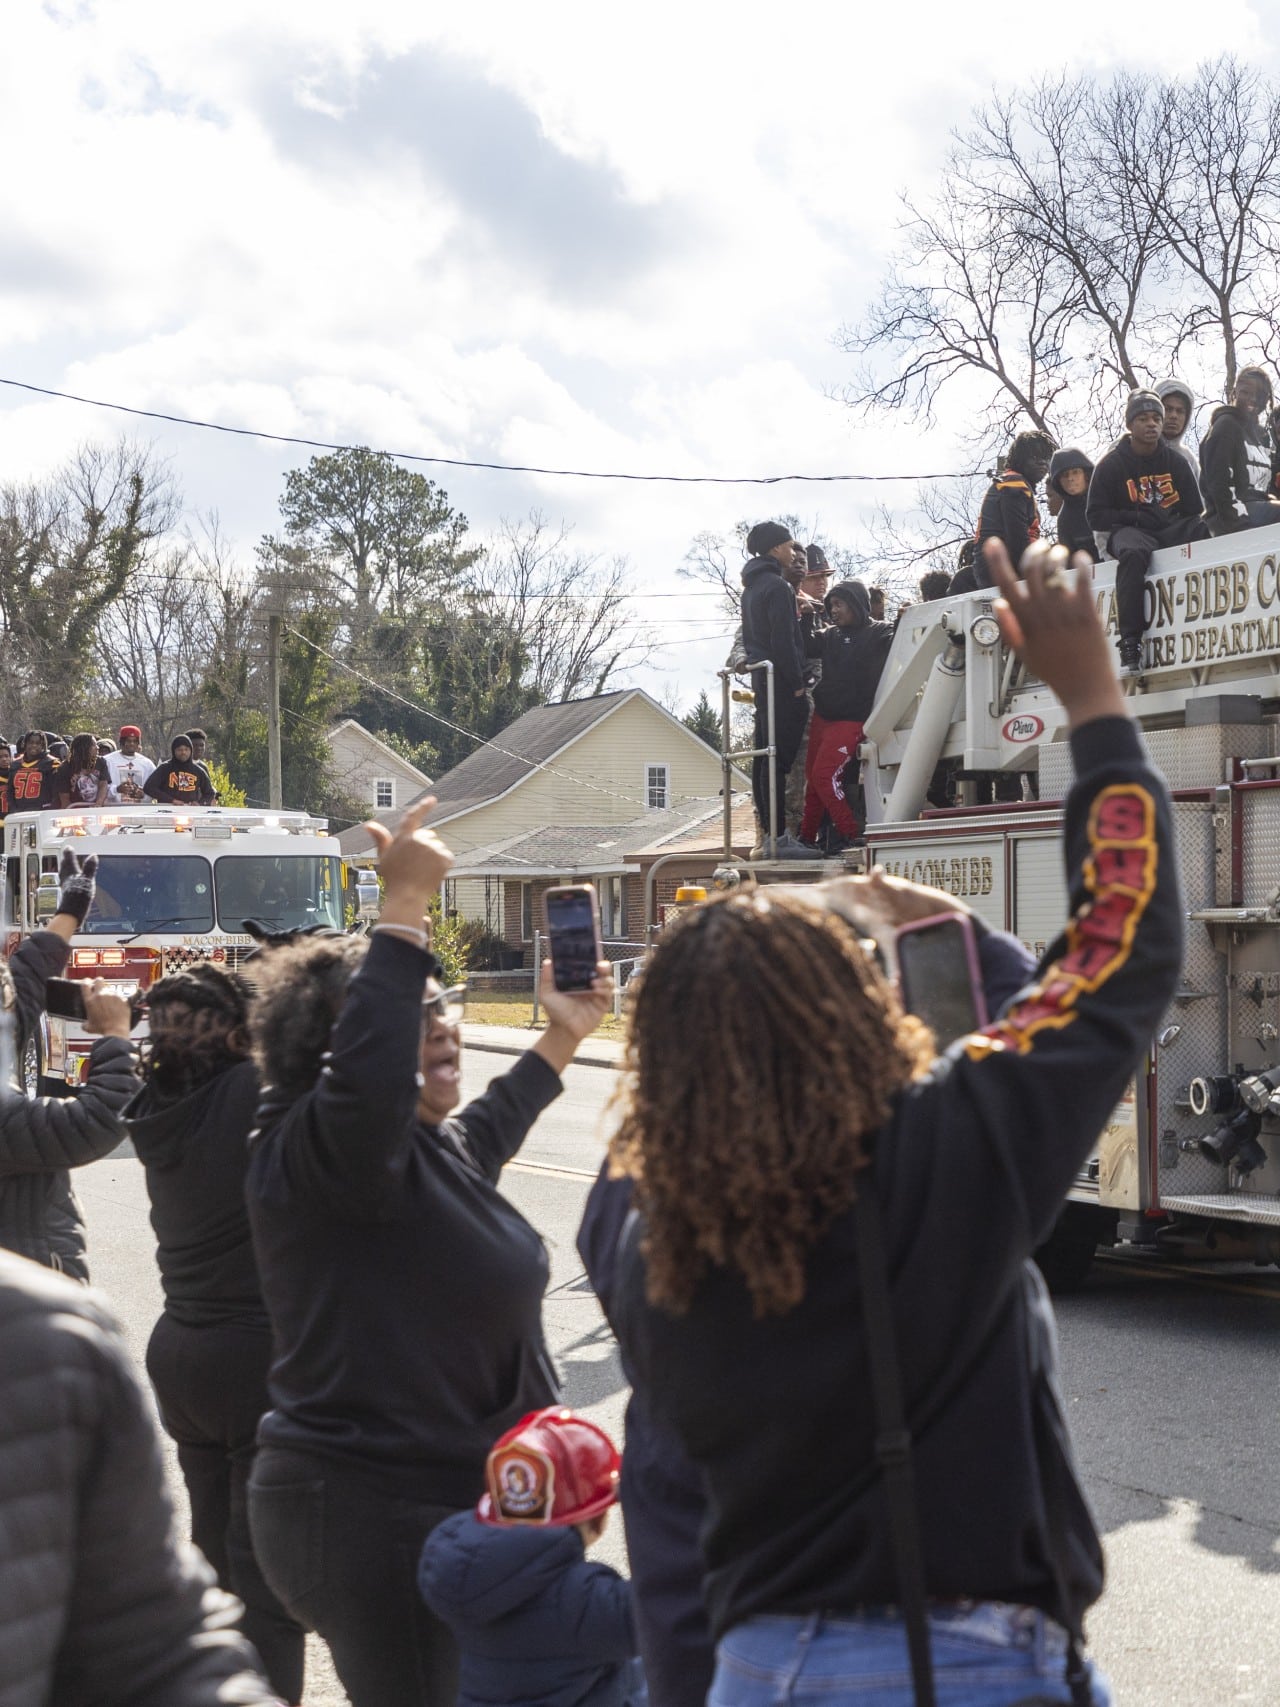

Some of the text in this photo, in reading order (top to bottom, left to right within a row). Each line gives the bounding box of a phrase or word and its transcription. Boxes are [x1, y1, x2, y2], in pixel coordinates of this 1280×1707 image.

[1141, 634, 1177, 669] IRE
[13, 771, 43, 799] 56
[183, 935, 252, 945] MACON-BIBB
